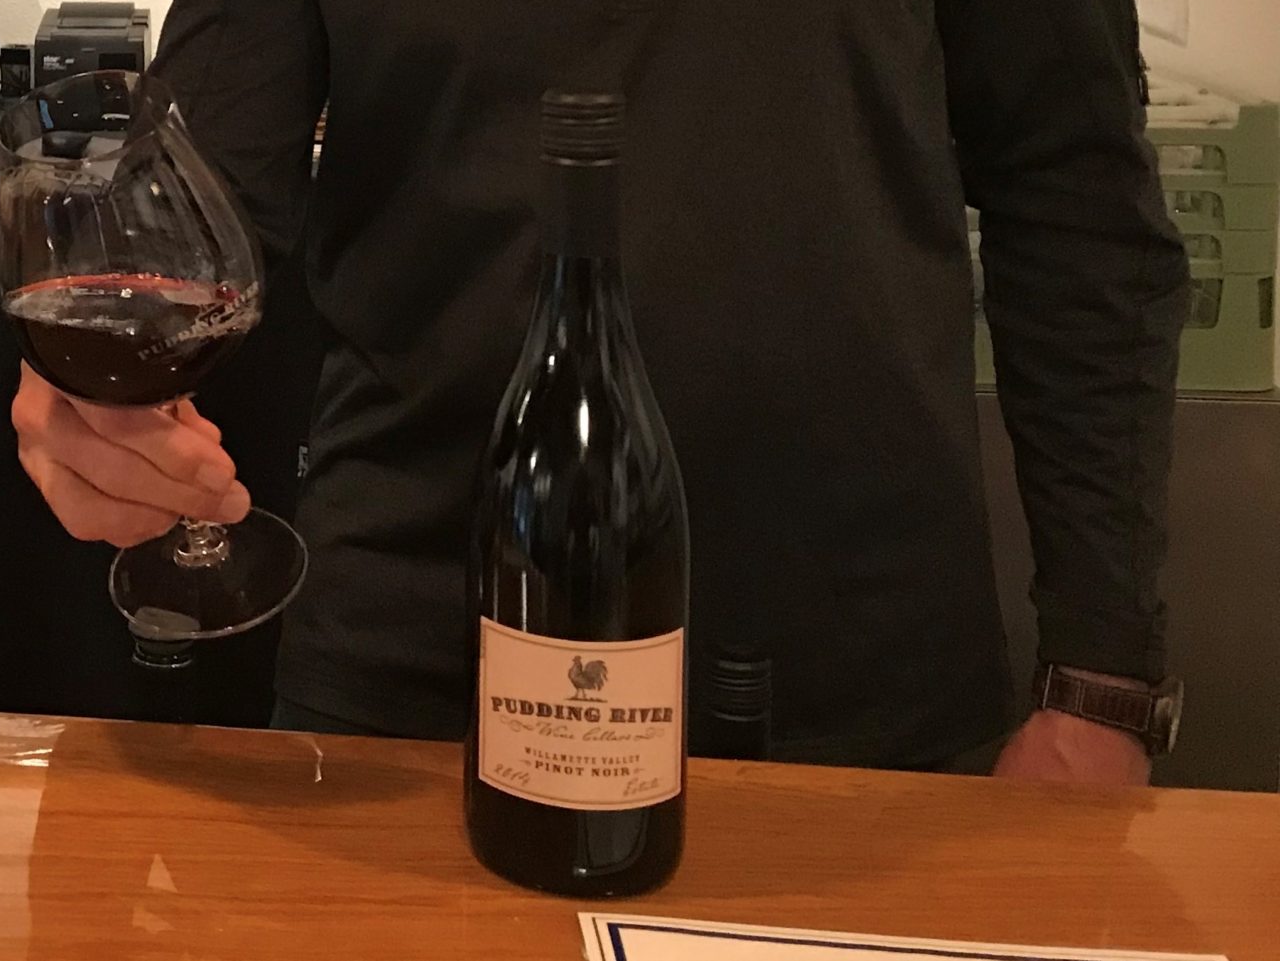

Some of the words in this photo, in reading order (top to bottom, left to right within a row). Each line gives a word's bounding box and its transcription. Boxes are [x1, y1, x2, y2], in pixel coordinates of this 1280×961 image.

[491, 696, 601, 723] PUDDING
[609, 707, 673, 723] RIVER
[535, 721, 574, 740] Wine
[524, 747, 597, 765] WILLAMETTE
[601, 754, 640, 765] VALLEY
[535, 760, 585, 777] PINOT
[591, 767, 631, 777] NOIR
